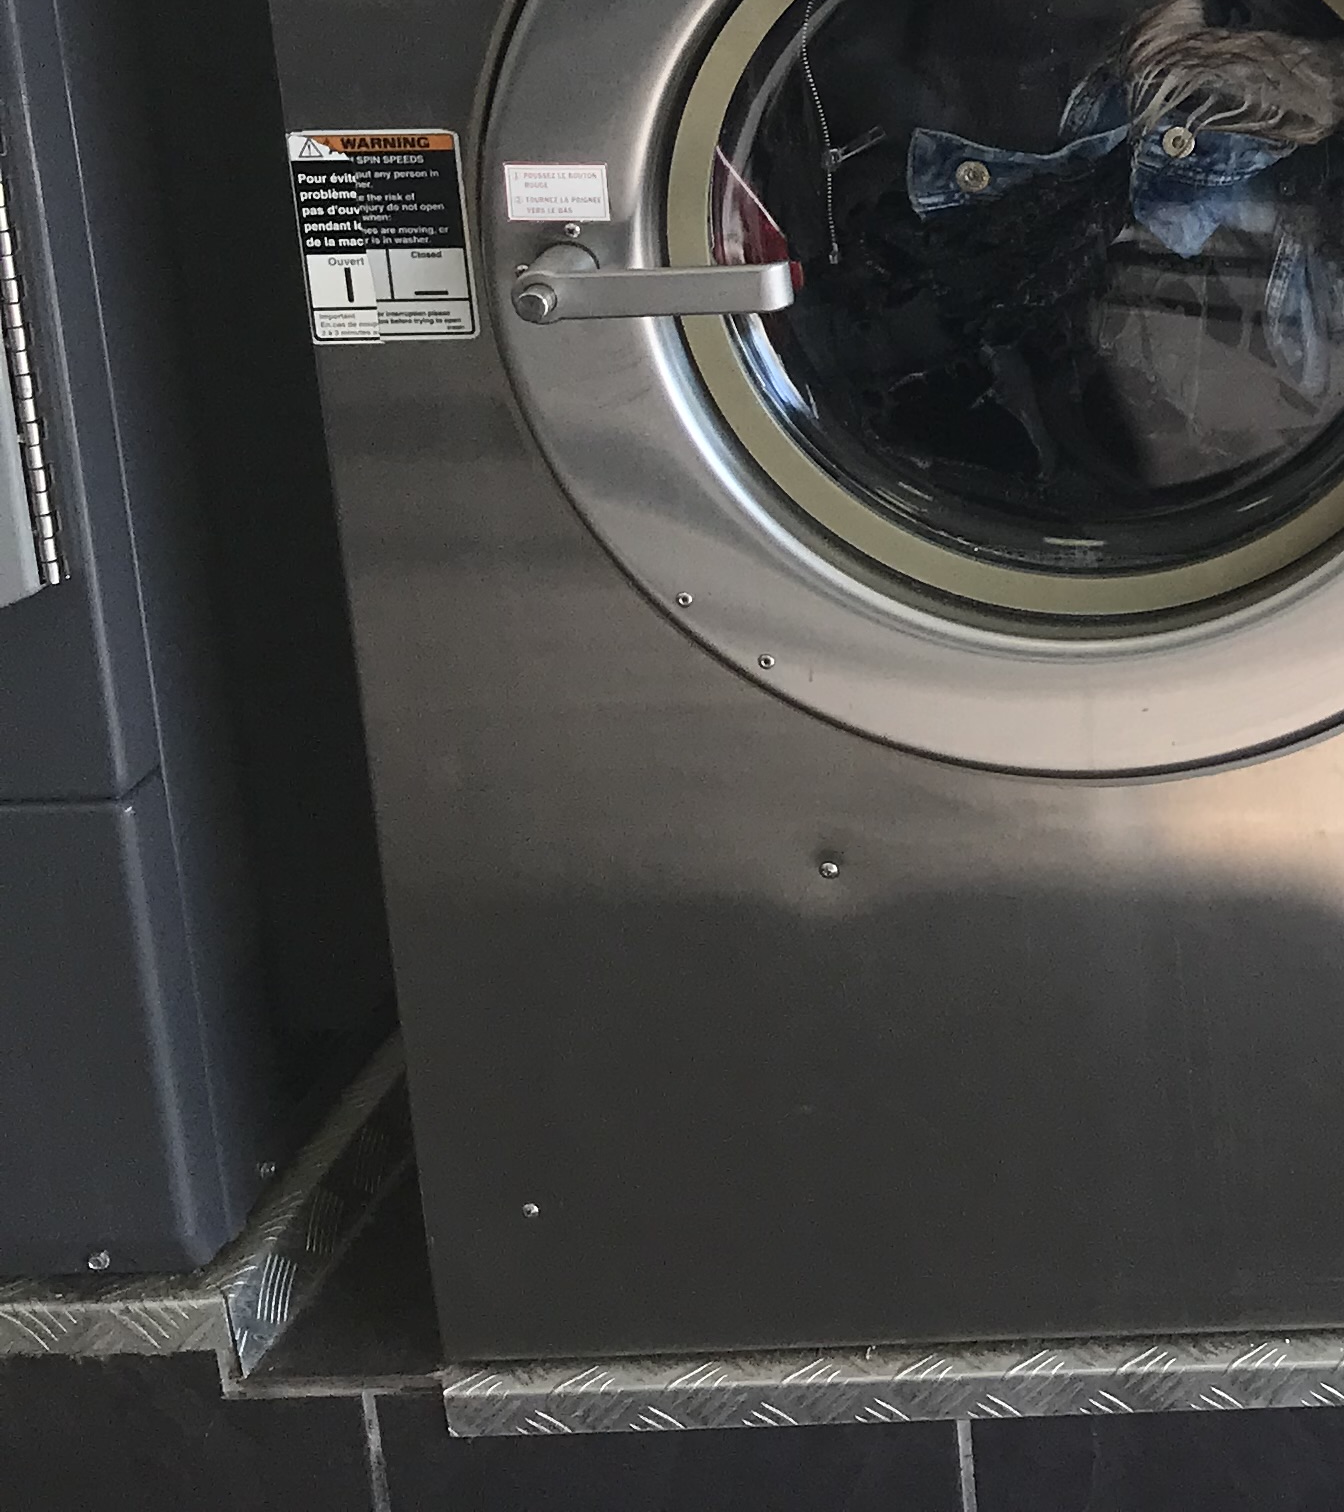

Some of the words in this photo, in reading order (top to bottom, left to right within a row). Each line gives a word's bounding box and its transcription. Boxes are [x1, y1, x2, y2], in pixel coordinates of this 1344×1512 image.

[340, 136, 430, 149] WARNING
[356, 155, 380, 164] SPIN
[383, 155, 424, 163] SPEEDS
[298, 173, 326, 184] Pour
[374, 171, 391, 179] any
[394, 170, 428, 179] person
[387, 203, 399, 211] do
[302, 207, 324, 218] pas
[304, 221, 350, 233] pendant
[306, 238, 321, 247] de
[325, 237, 336, 247] la
[411, 250, 442, 258] Closed
[328, 257, 364, 266] Ouvert
